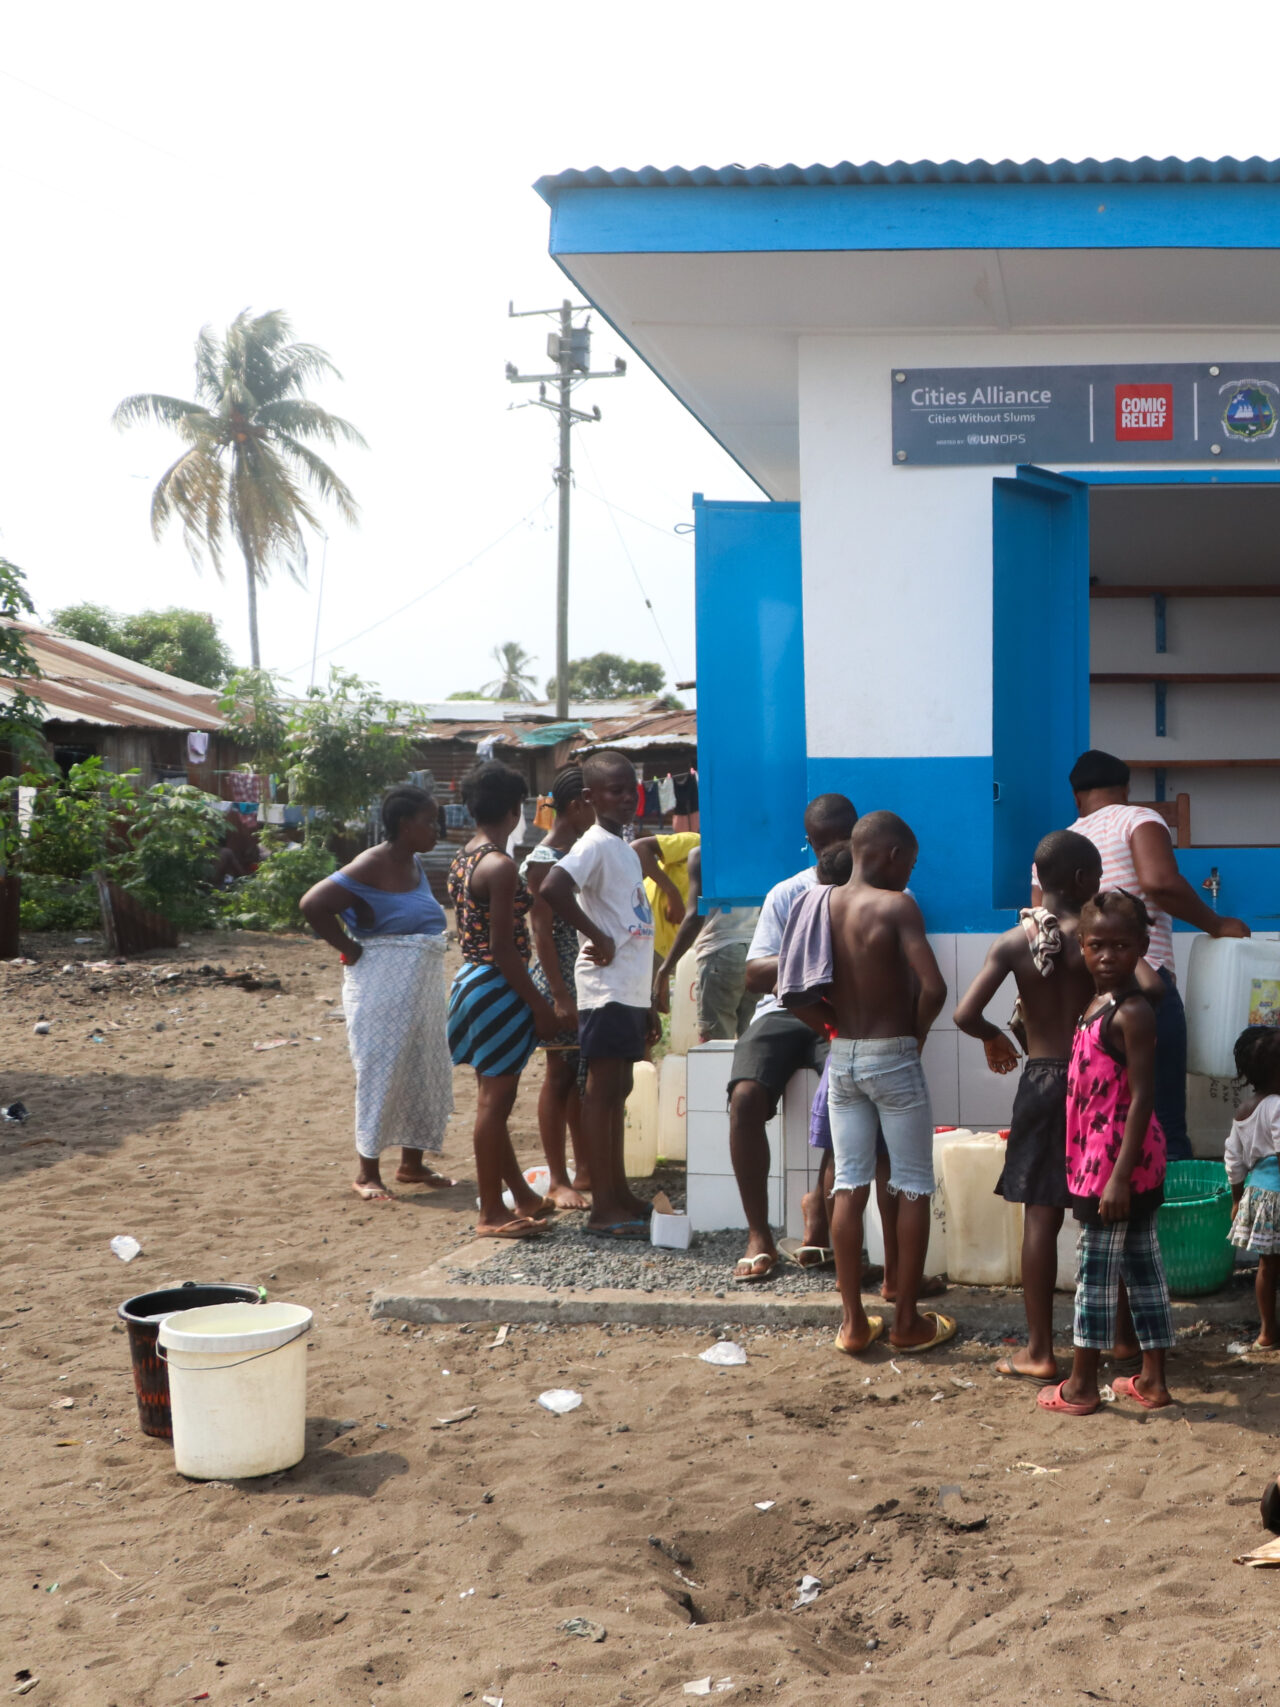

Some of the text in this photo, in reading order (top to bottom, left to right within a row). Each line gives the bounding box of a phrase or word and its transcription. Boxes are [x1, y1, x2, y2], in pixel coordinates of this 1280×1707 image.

[911, 386, 1052, 406] Cities Alliance
[1121, 397, 1167, 412] COMIC
[928, 412, 1036, 424] Cities Without Slums
[1121, 412, 1167, 428] RELIEF
[980, 433, 1026, 445] UNOPS
